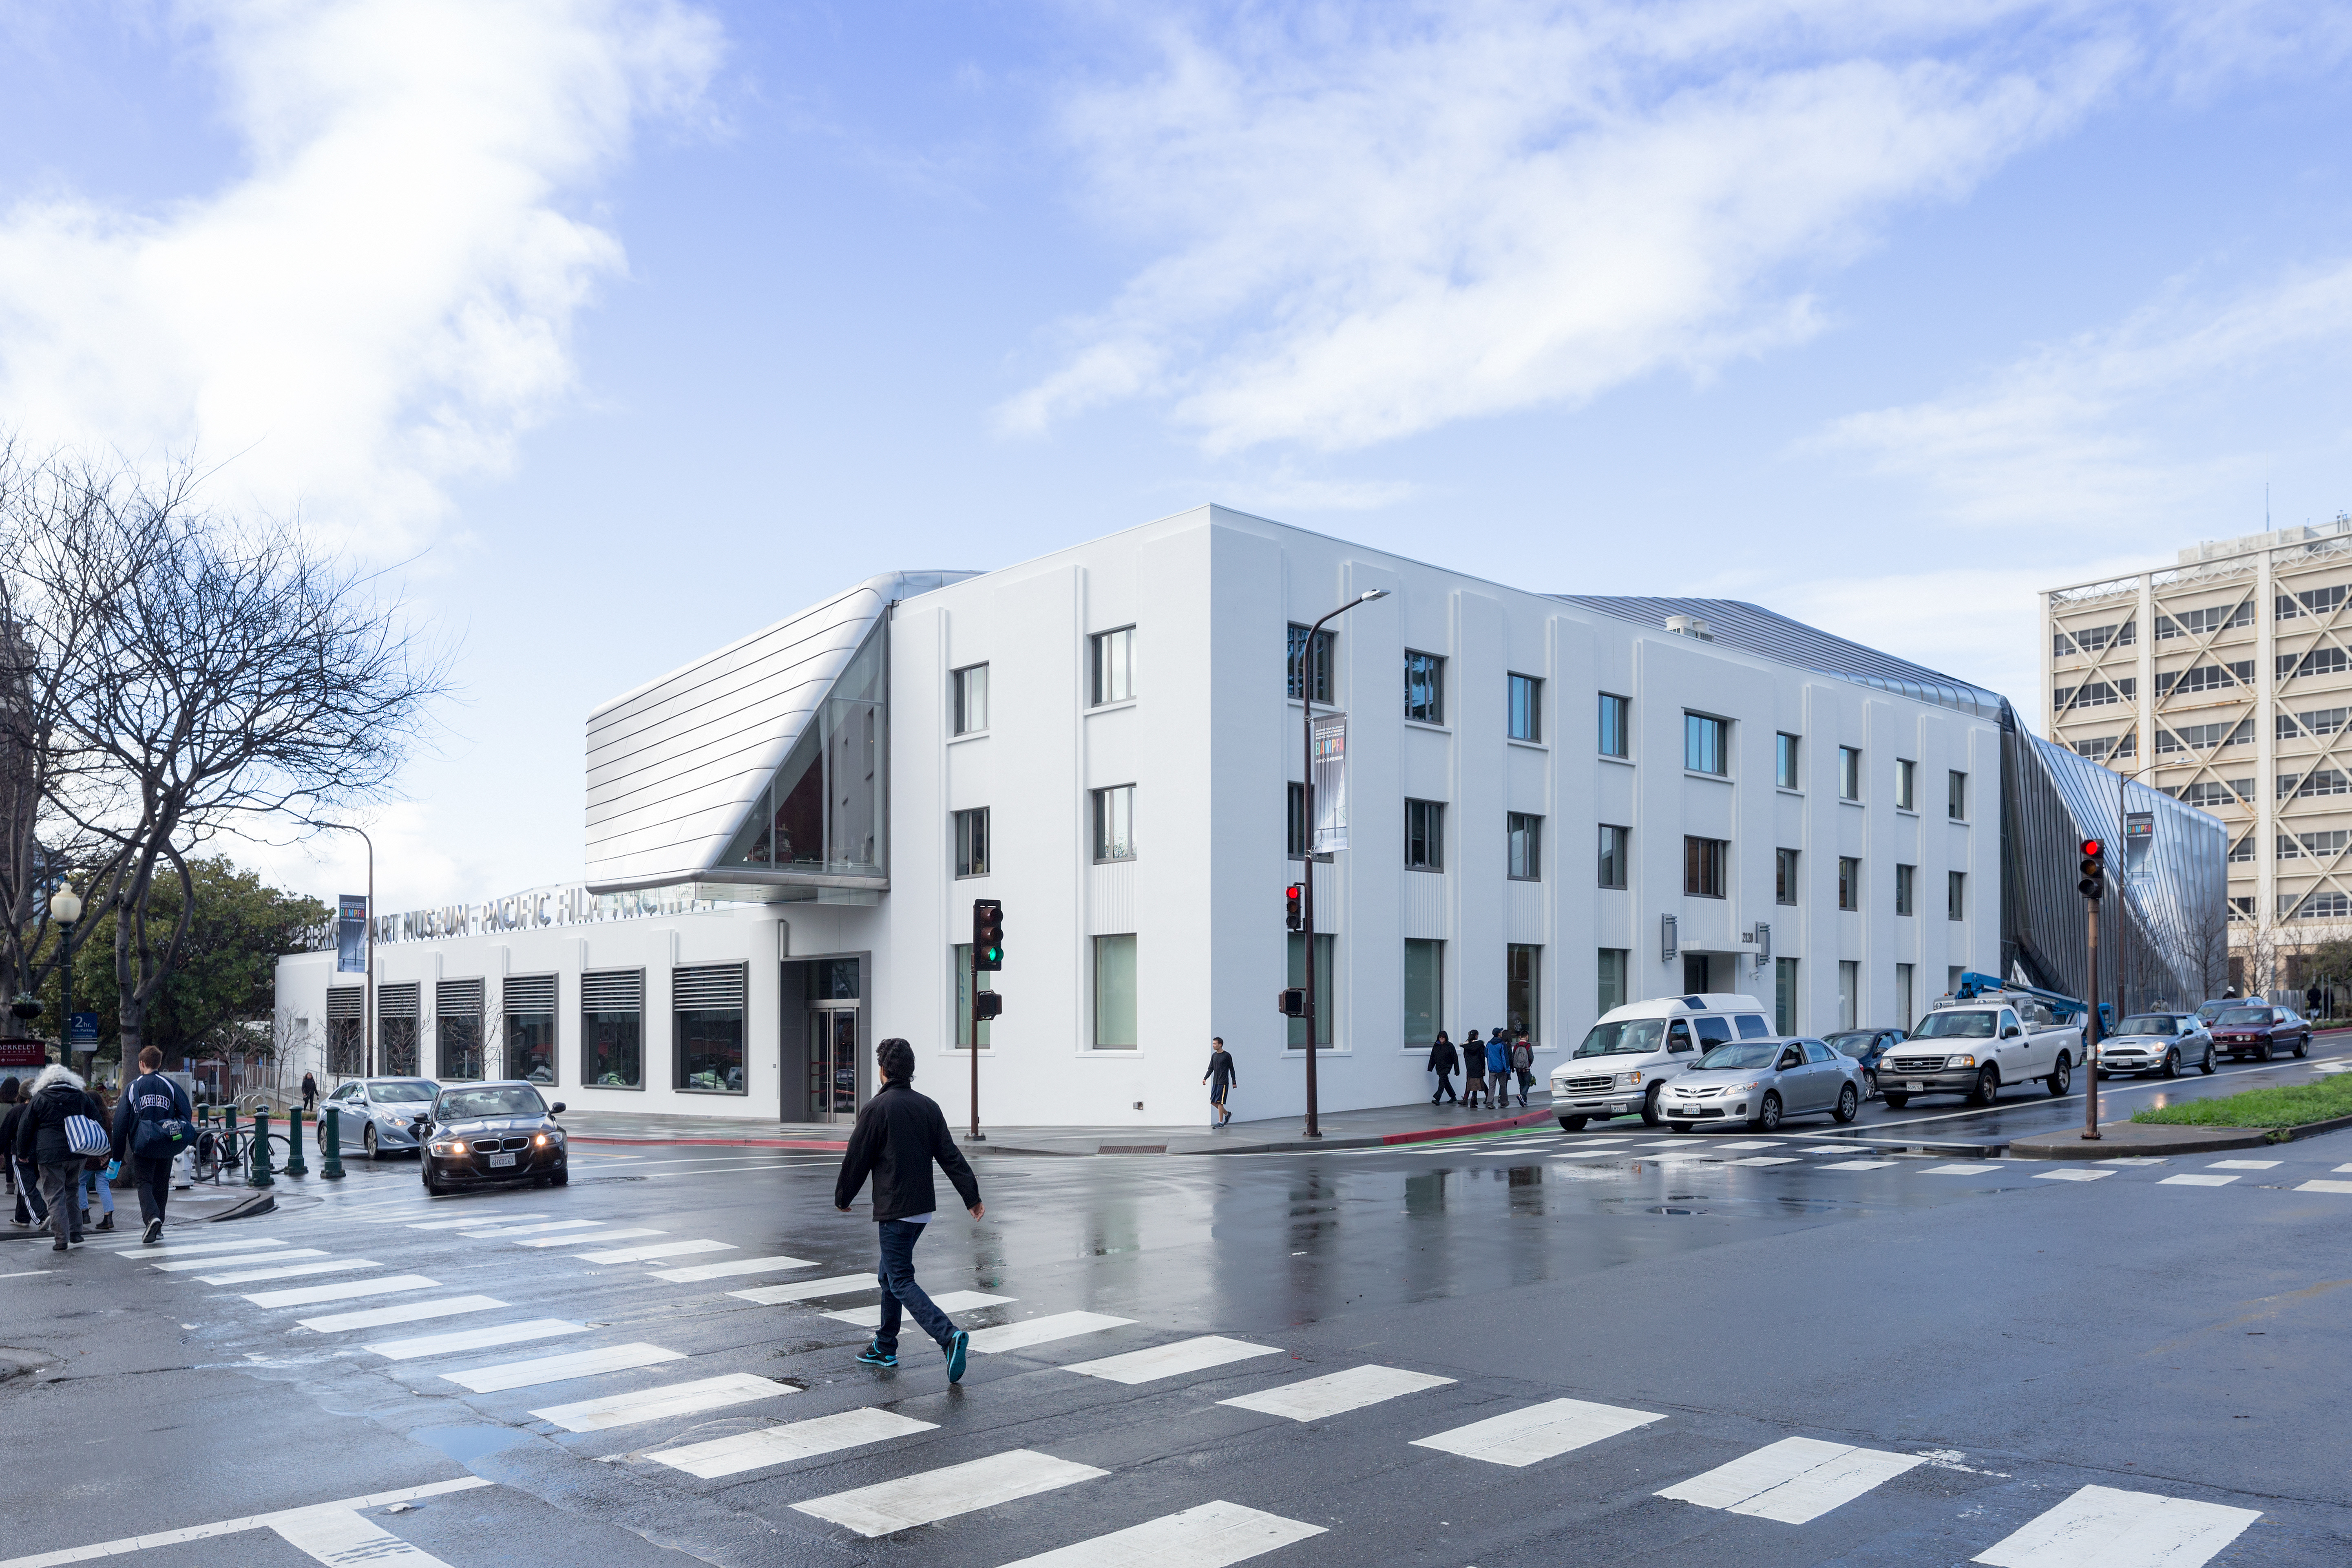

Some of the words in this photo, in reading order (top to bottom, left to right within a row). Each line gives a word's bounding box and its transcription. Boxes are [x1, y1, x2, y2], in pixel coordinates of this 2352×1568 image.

[1315, 737, 1344, 755] BAMPFA
[2128, 824, 2151, 834] BAMPFA
[340, 908, 364, 917] BAMPFA
[373, 914, 401, 943] ART
[404, 904, 469, 940] MUSEUM
[481, 892, 551, 932] PACIFIC
[557, 888, 604, 923] FILM
[133, 1094, 156, 1113] CLLEGE
[156, 1095, 170, 1110] PREP
